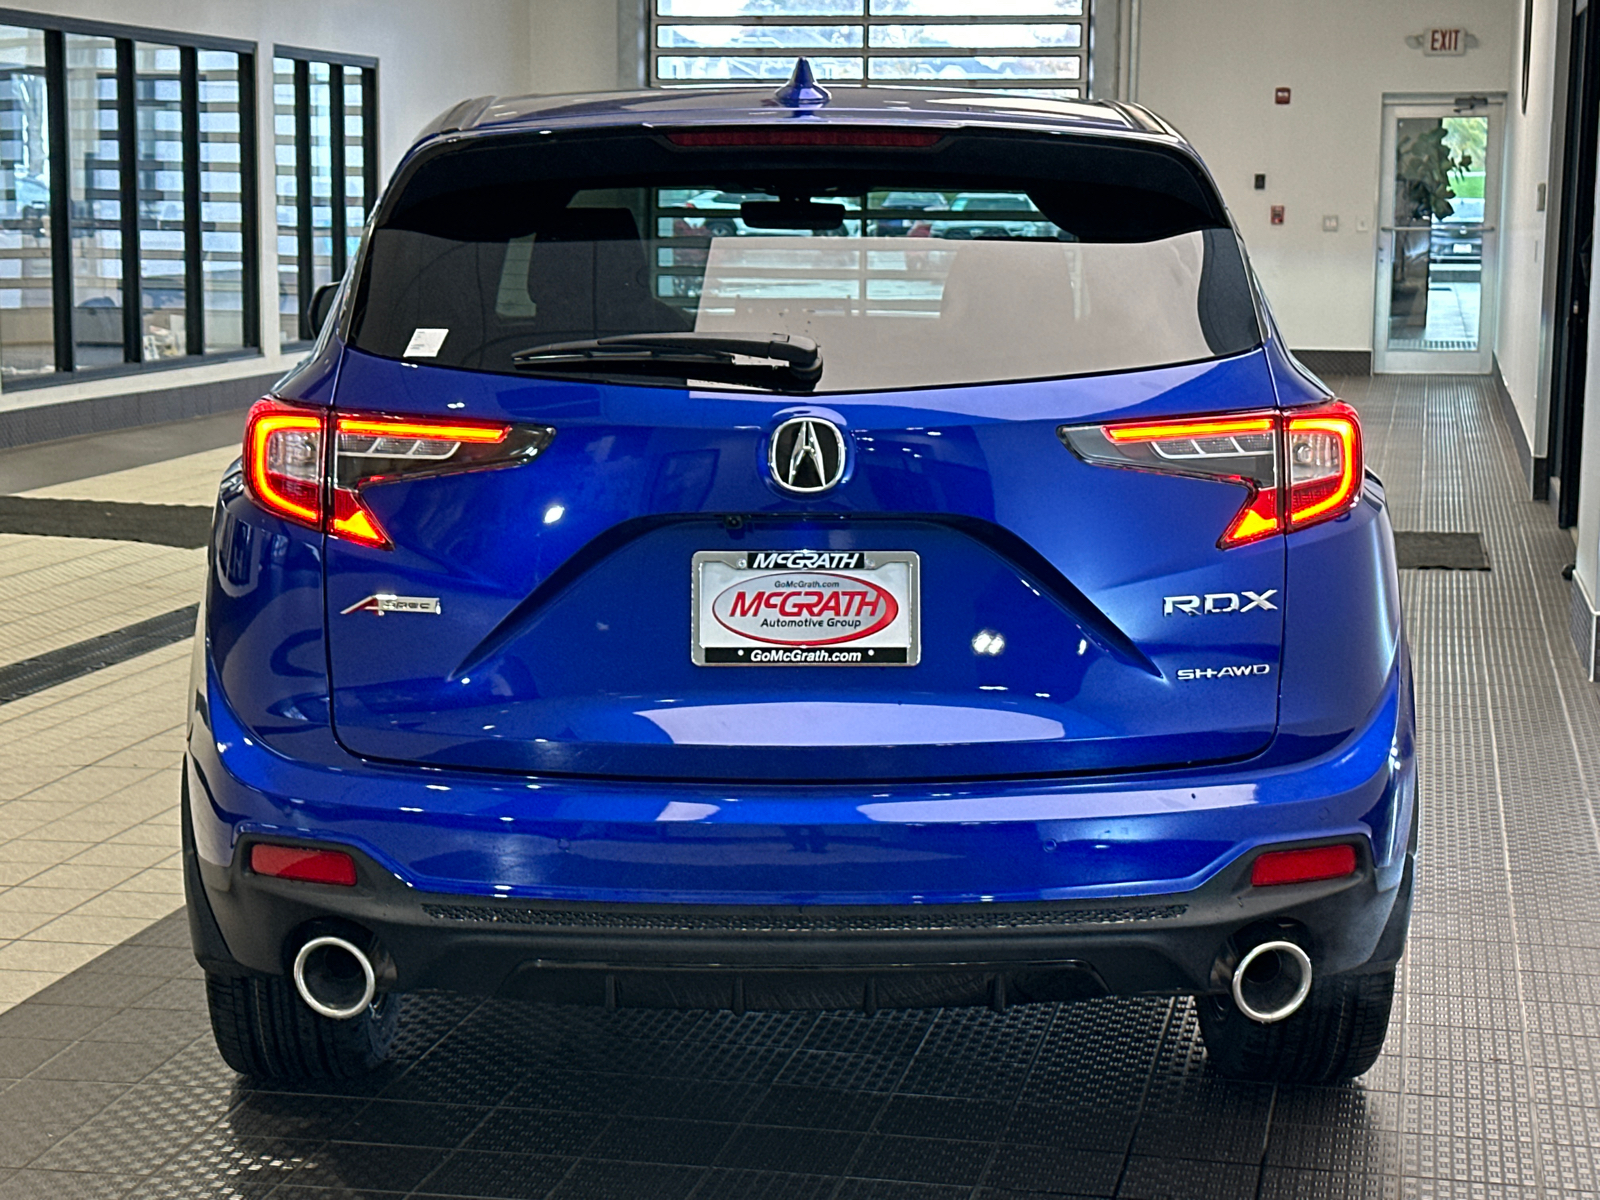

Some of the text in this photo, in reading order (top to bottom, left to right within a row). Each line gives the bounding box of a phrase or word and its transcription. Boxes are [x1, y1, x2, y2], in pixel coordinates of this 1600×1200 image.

[1431, 29, 1461, 51] EXIT
[774, 580, 840, 589] GoMcGrath.com
[1163, 589, 1278, 617] RDX
[760, 617, 861, 630] Automotive Group
[750, 649, 862, 662] GoMcGrath.com
[1177, 663, 1270, 680] SH-AWD
